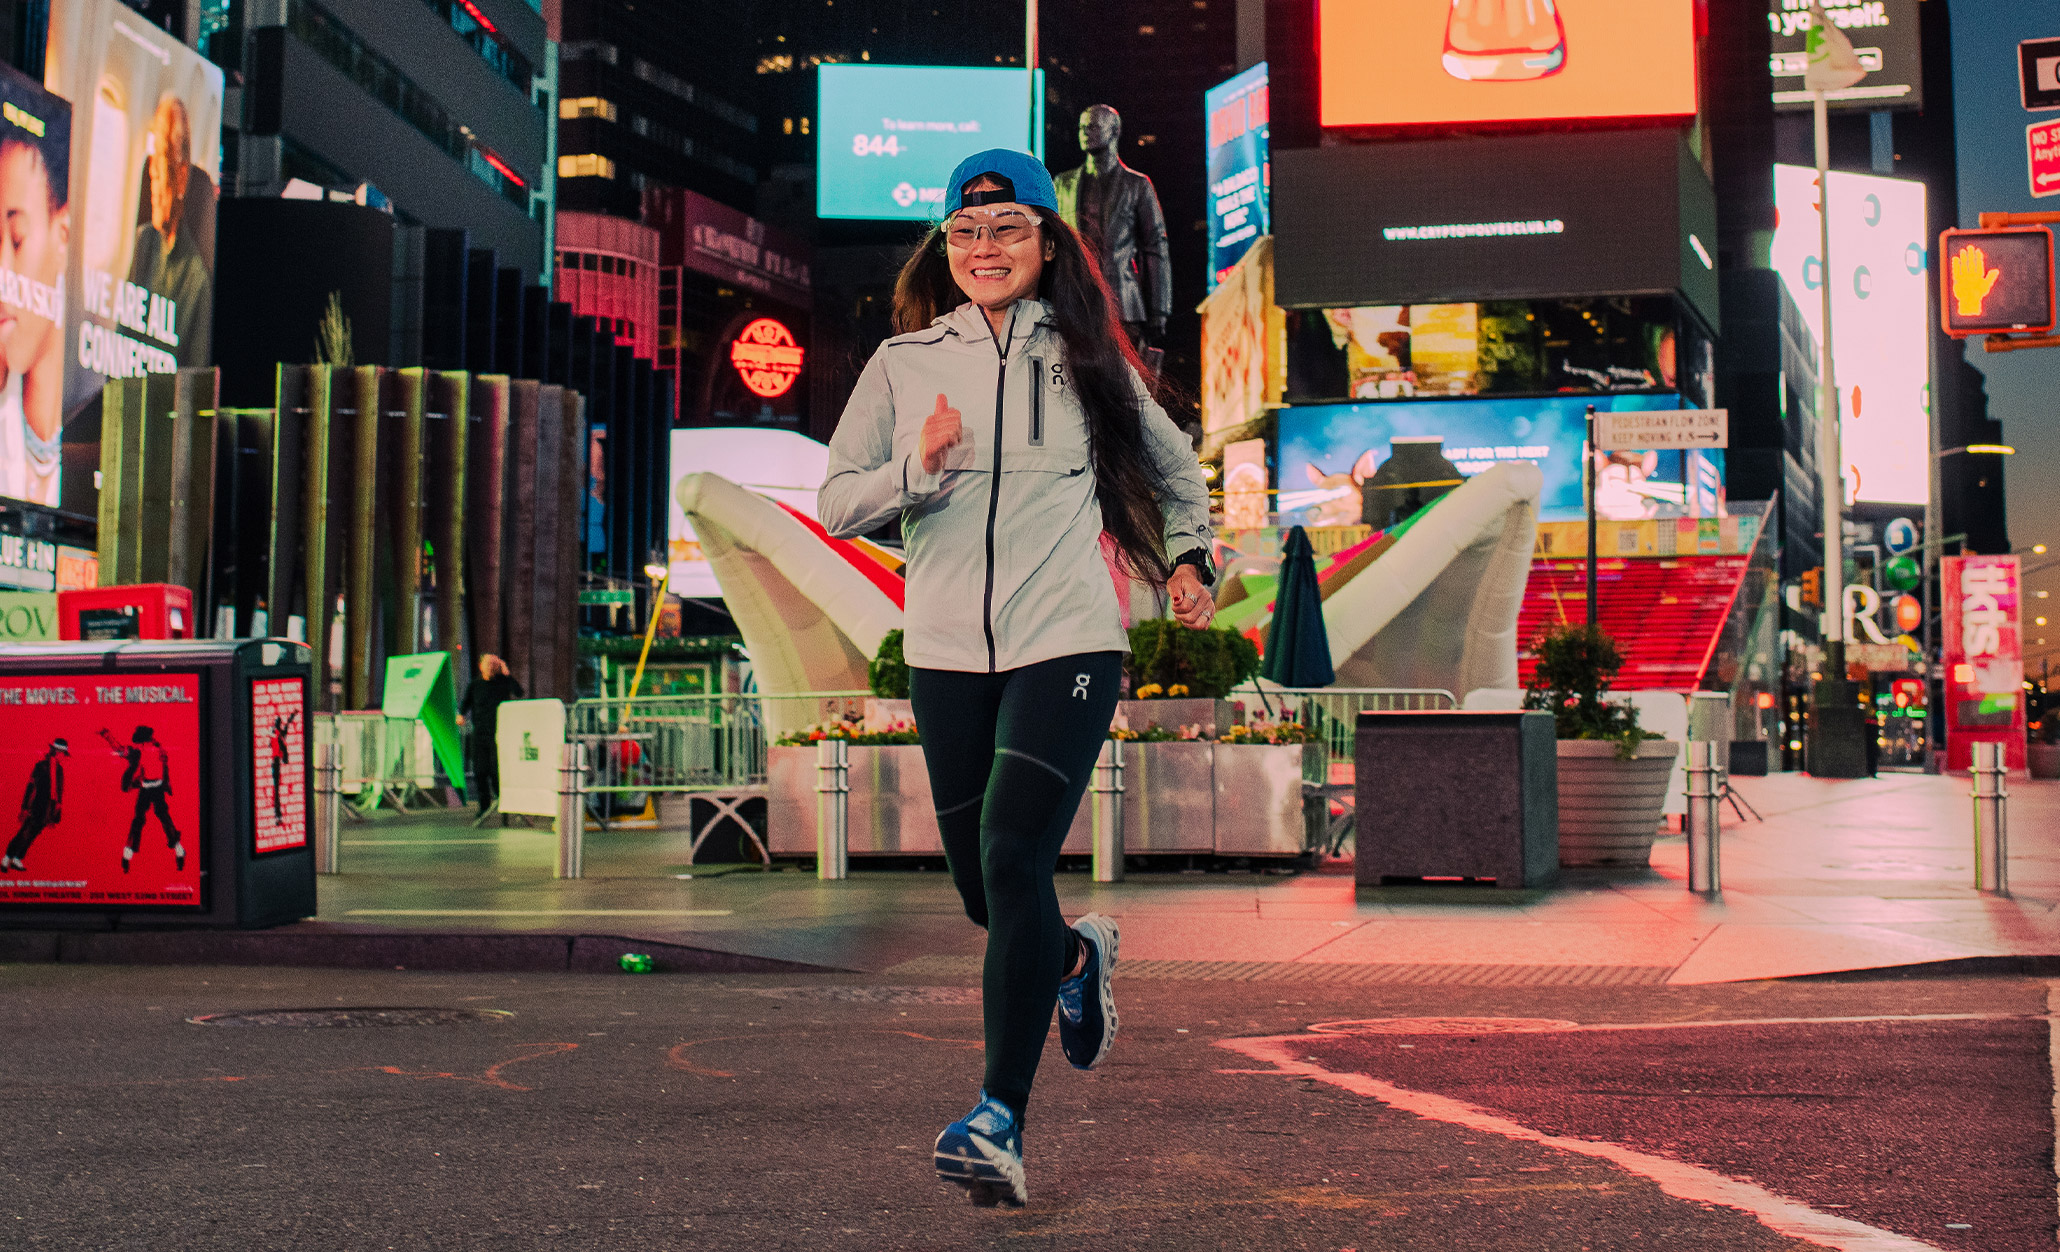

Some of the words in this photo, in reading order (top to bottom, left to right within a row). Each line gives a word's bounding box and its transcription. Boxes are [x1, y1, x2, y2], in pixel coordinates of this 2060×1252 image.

[83, 266, 112, 320] WE
[113, 278, 150, 335] ARE
[146, 291, 180, 348] ALL
[78, 319, 178, 379] CONNECTED
[1611, 415, 1668, 429] PEDESTRIAN
[1669, 414, 1695, 428] FLOW
[1697, 413, 1720, 427] ZONE
[1611, 431, 1635, 444] KEEP
[1637, 431, 1672, 443] MOVING
[95, 686, 124, 704] THE
[125, 685, 194, 704] MUSICAL.
